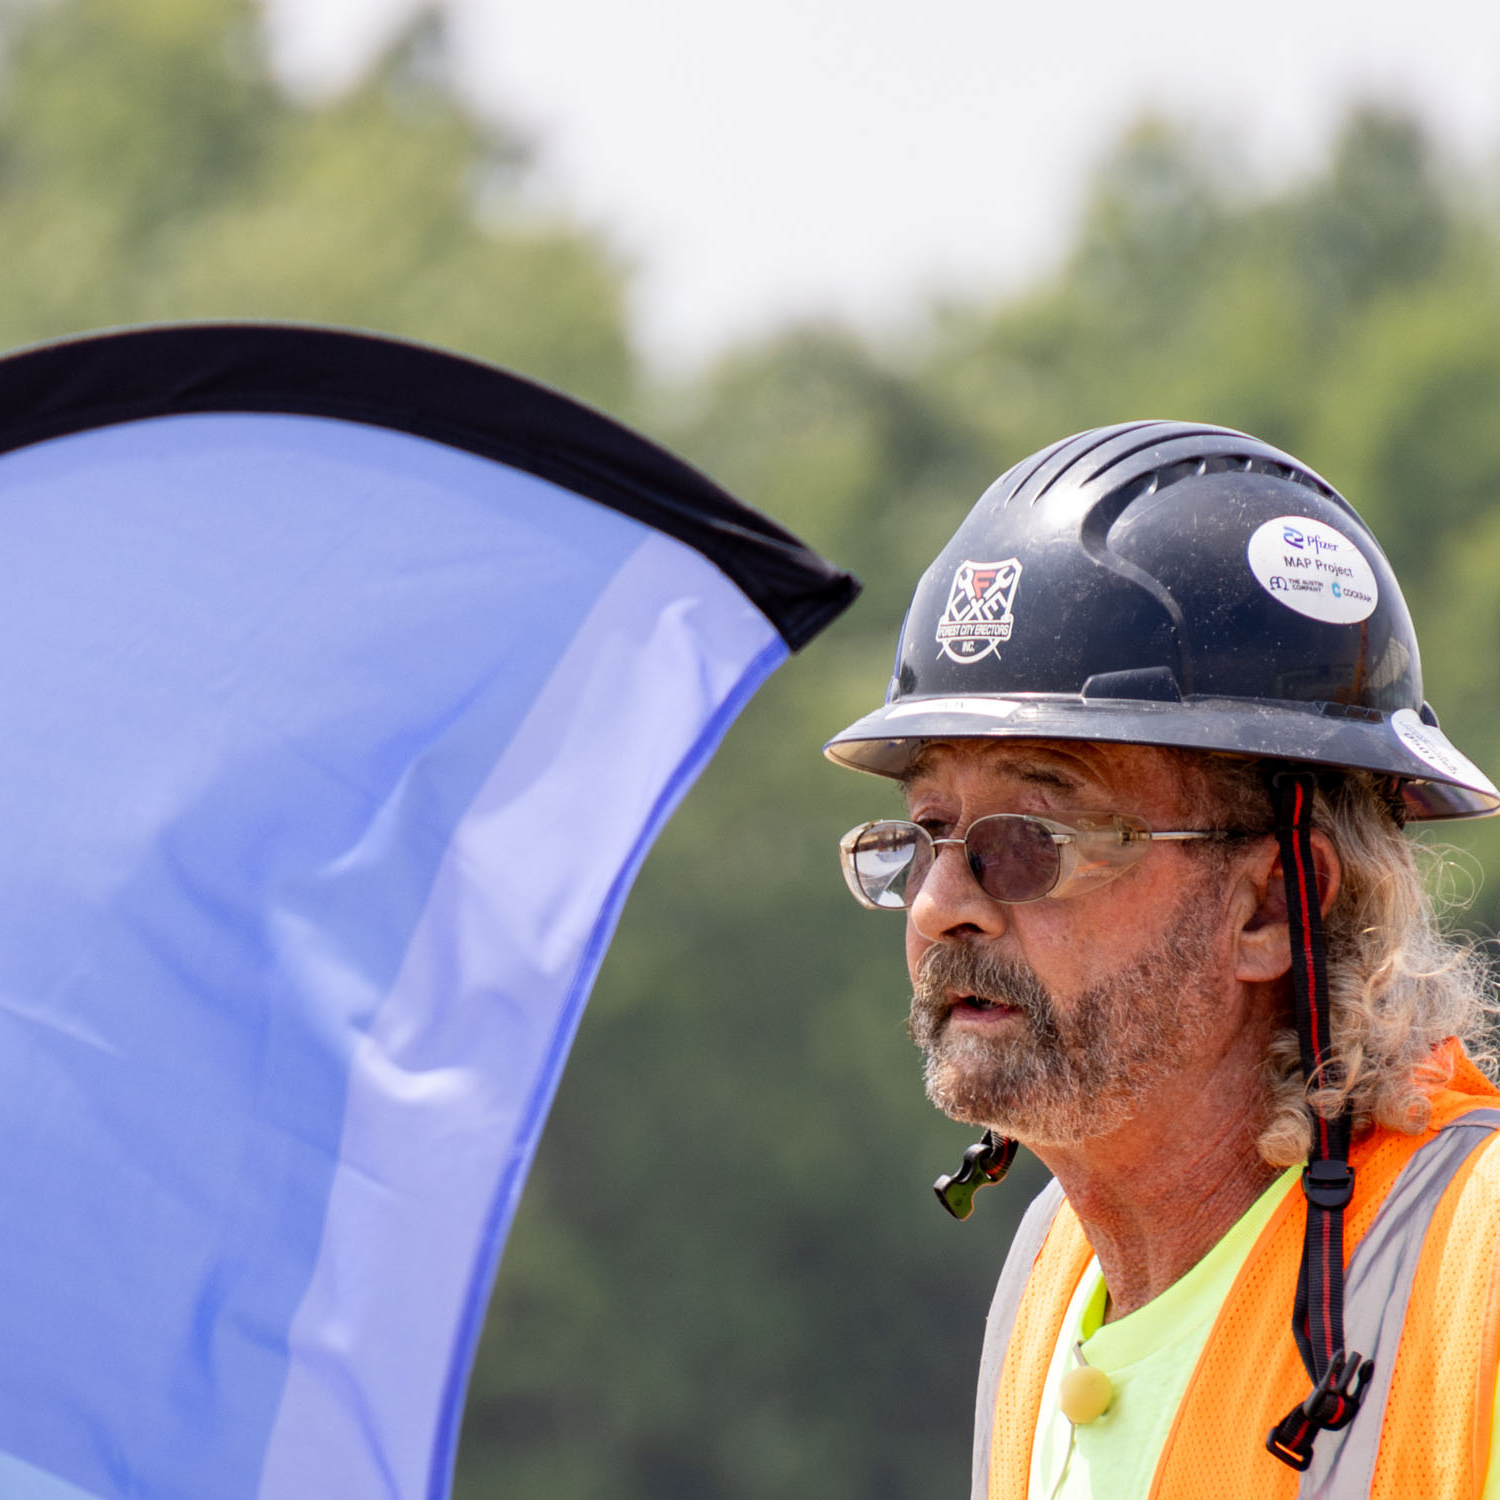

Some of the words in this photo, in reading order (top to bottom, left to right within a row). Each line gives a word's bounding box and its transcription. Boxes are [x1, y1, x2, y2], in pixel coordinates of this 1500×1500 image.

[1284, 556, 1311, 568] MAP
[1316, 560, 1353, 577] Project
[972, 570, 997, 599] F
[1293, 585, 1322, 593] COMPANY
[939, 625, 961, 638] FOREST
[960, 624, 975, 636] CITY
[975, 623, 1010, 637] ERECTORS
